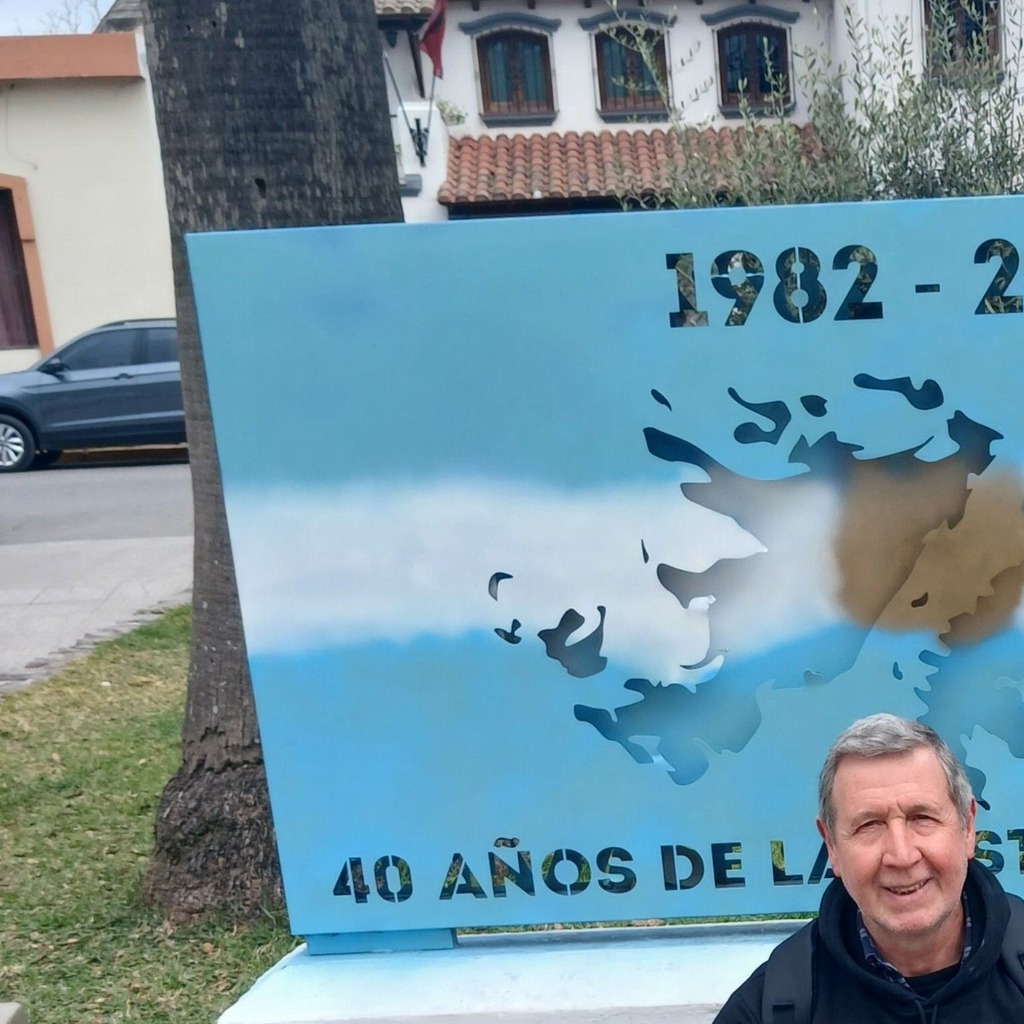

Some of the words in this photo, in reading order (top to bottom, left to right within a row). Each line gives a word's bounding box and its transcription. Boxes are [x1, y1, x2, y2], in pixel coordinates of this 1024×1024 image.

[666, 245, 884, 328] 1982
[914, 283, 941, 293] -
[332, 855, 414, 904] 40
[439, 838, 637, 899] AÑOS
[659, 841, 748, 892] DE
